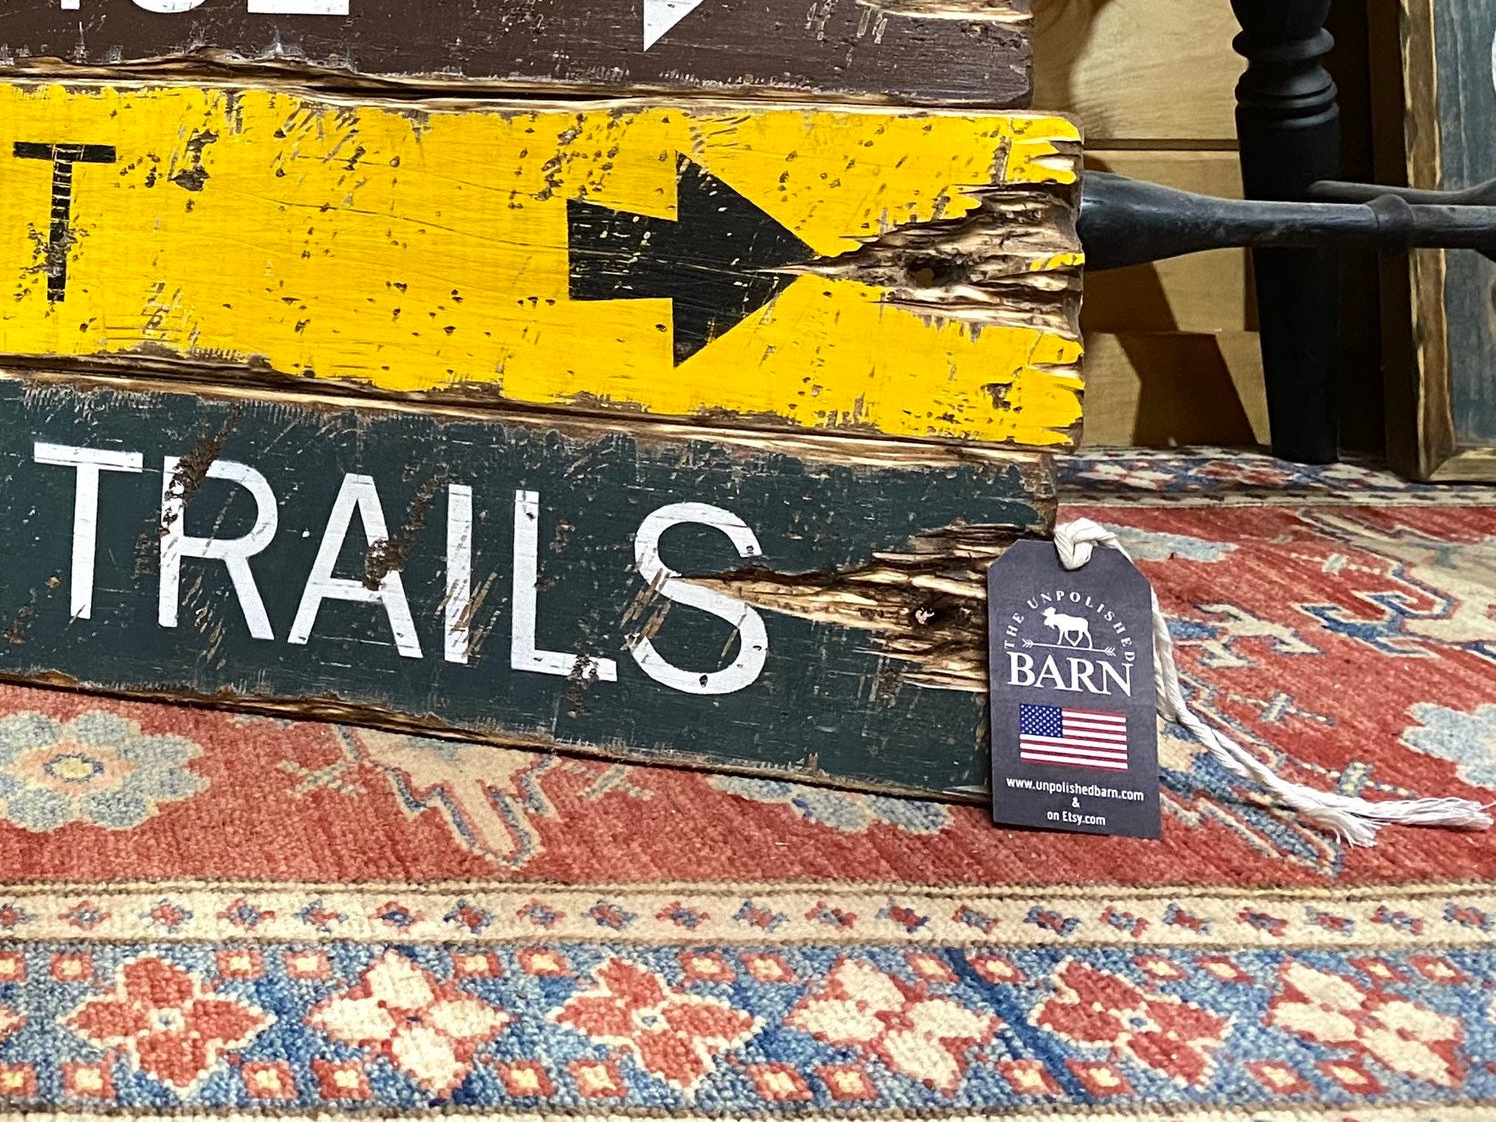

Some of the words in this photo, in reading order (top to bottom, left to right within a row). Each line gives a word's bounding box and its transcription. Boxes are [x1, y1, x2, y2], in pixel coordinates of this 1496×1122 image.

[34, 442, 769, 695] TRAILS
[1004, 612, 1025, 649] THE
[1027, 590, 1136, 662] UNPOLISHED
[1006, 651, 1134, 697] BARN
[1005, 777, 1145, 802] www.unpolishedbarn.com
[1071, 796, 1081, 808] &
[1047, 810, 1060, 821] on
[1062, 810, 1106, 826] Etsy.com
